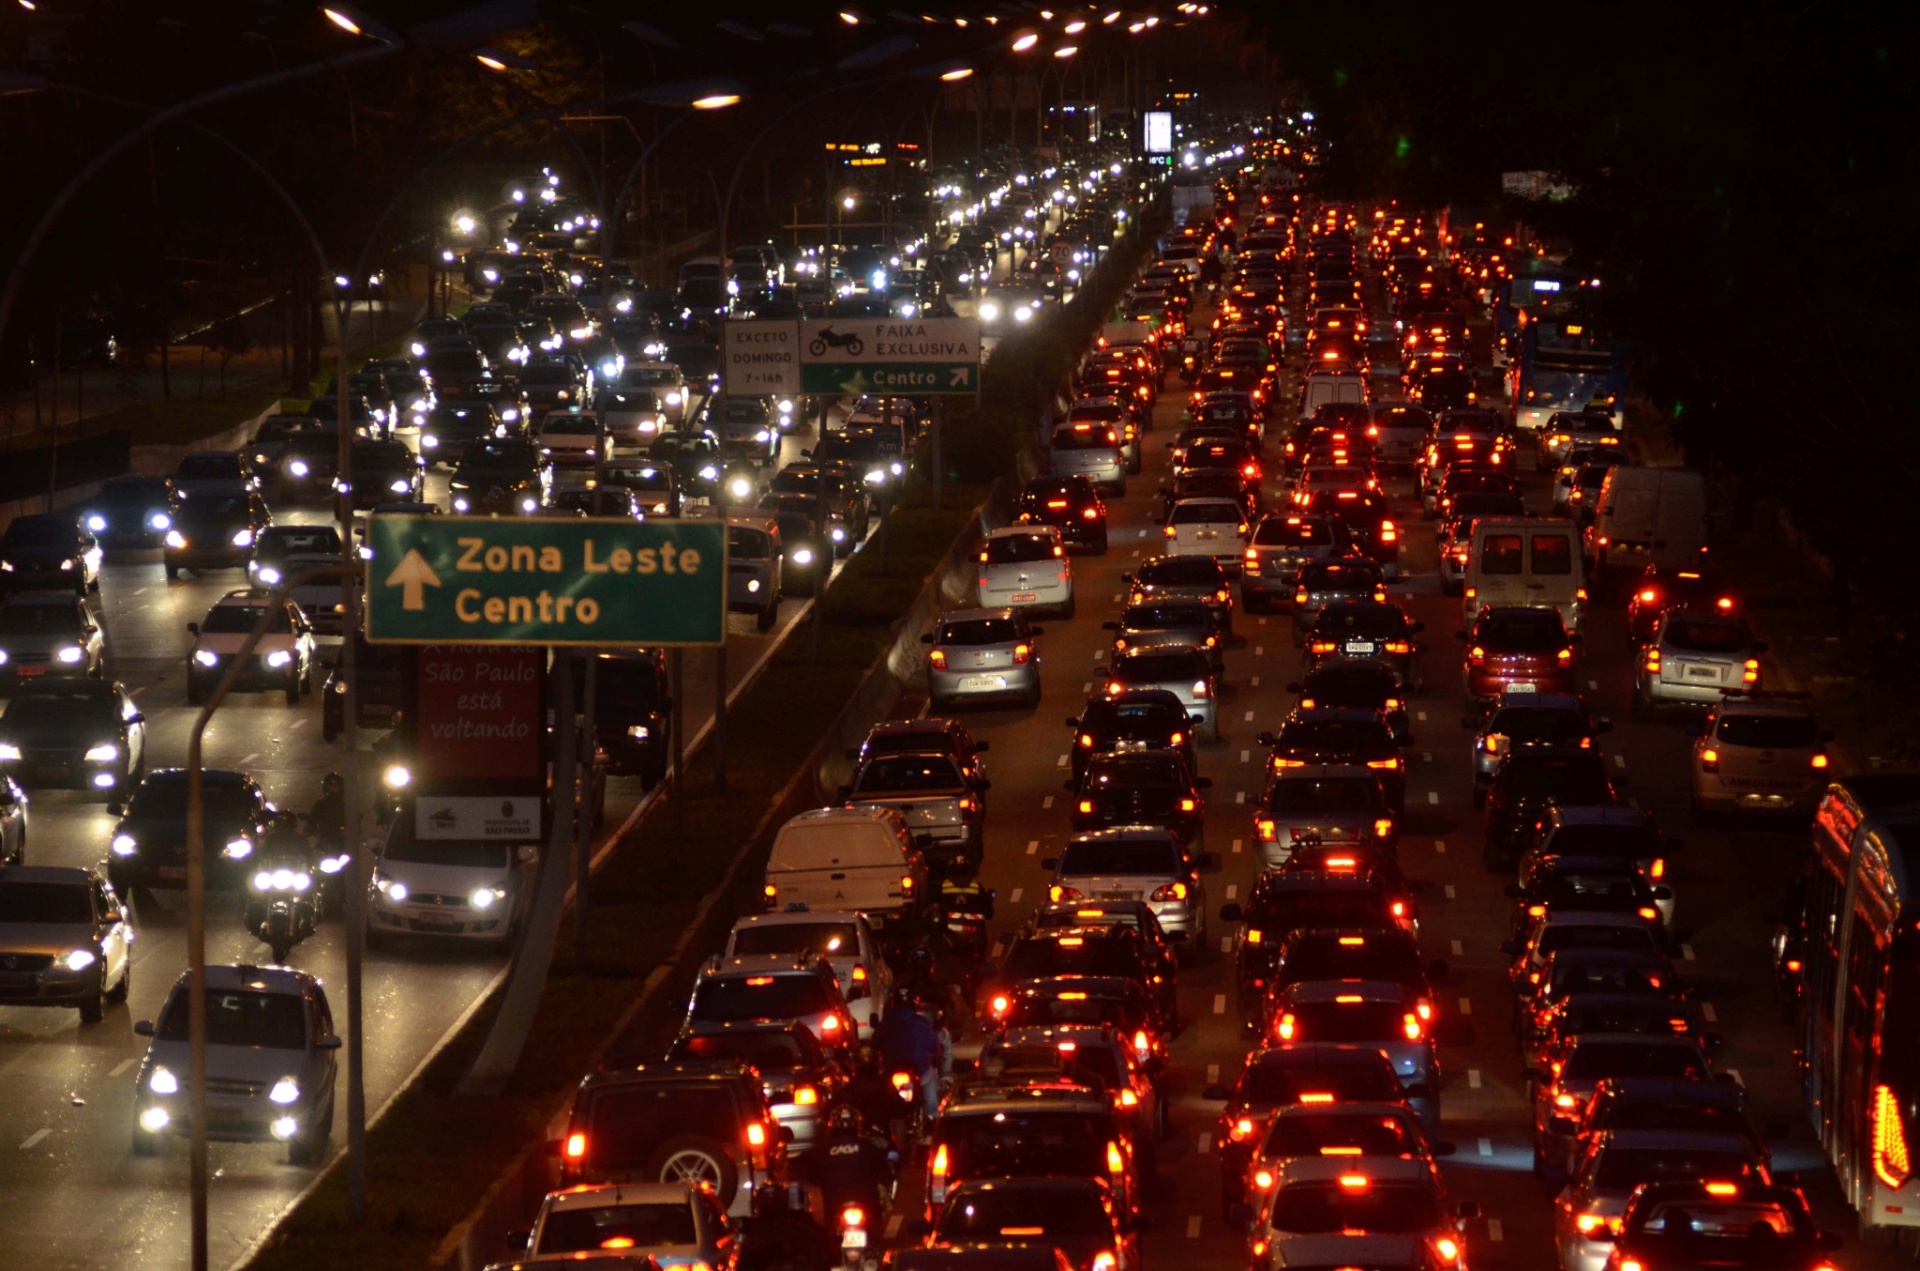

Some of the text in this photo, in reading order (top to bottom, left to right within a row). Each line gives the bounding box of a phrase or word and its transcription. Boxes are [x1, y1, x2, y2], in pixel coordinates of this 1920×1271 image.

[1055, 246, 1069, 257] 70
[737, 332, 787, 343] EXCETO
[876, 325, 926, 337] FAIXA
[877, 343, 968, 355] EXCLUSIVA
[733, 352, 792, 364] DOMINGO
[873, 371, 936, 385] Centro
[456, 537, 701, 574] Zona Leste
[455, 588, 600, 624] Centro
[425, 661, 536, 682] São Paulo
[457, 690, 503, 710] está
[430, 717, 529, 738] voltando
